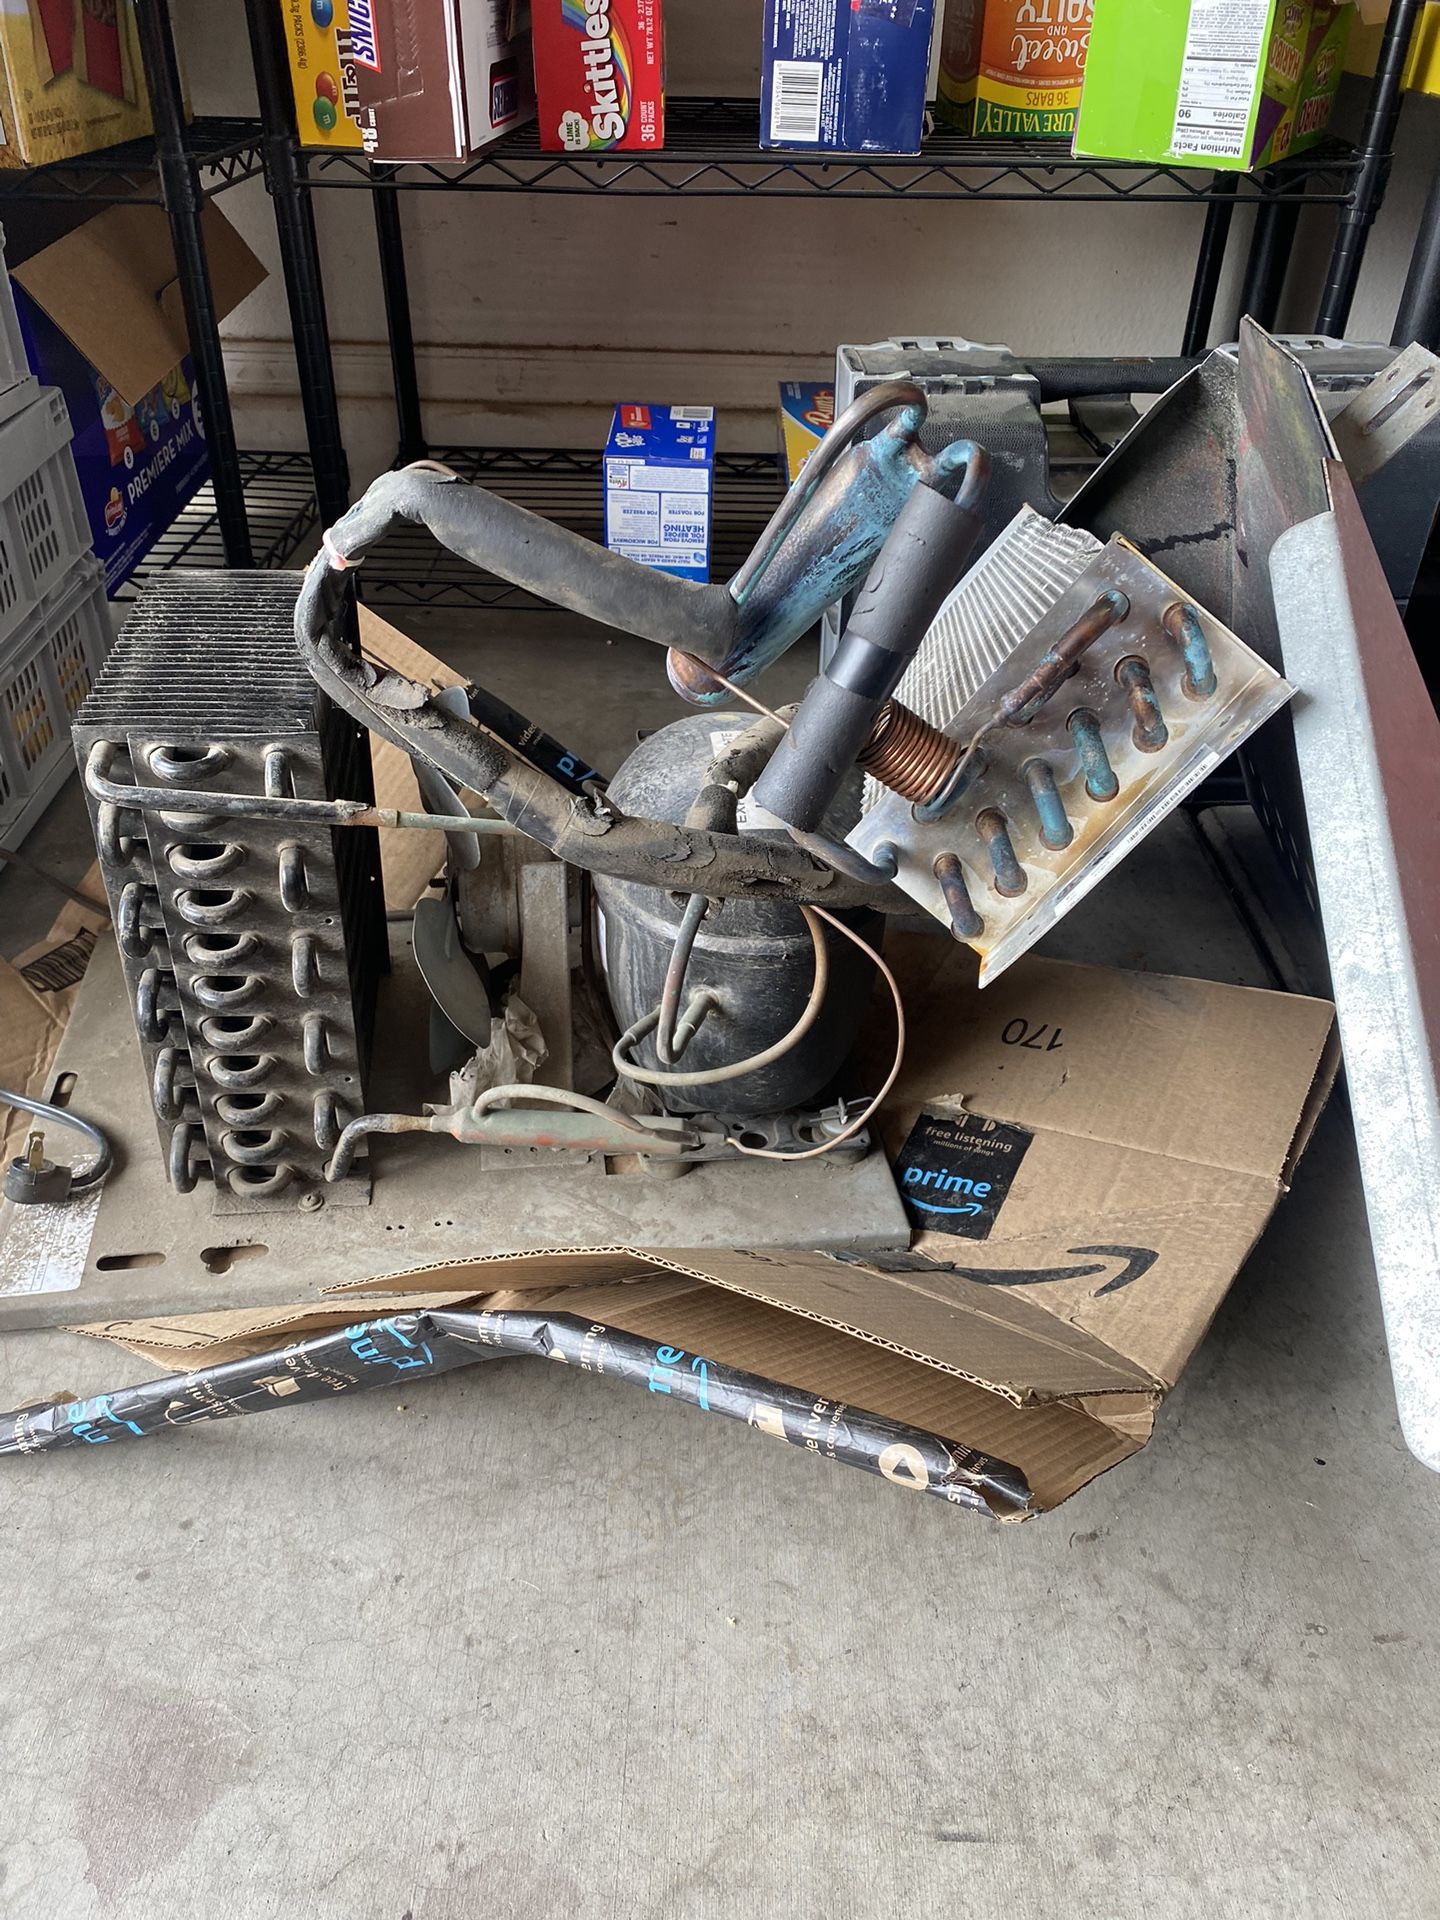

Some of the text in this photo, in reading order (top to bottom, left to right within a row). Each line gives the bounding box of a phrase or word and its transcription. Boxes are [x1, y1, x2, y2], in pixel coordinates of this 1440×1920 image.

[293, 15, 304, 36] PACKS
[638, 20, 646, 31] 36
[1047, 25, 1068, 36] AND
[647, 37, 655, 50] WT
[1011, 33, 1088, 71] Sweet
[647, 51, 655, 65] NET
[579, 0, 625, 140] Skittles
[1026, 91, 1069, 106] 36 BARS
[647, 101, 655, 123] PACKS
[979, 102, 1041, 133] VALLEY
[1178, 109, 1247, 120] Calories 90
[363, 128, 379, 153] 48
[575, 137, 581, 145] IS
[641, 123, 656, 142] 36
[1173, 141, 1241, 155] Nutrition Facts
[127, 445, 177, 505] PREMIERE
[174, 419, 194, 454] MIX
[663, 524, 705, 533] HEATING
[1001, 1017, 1064, 1052] 170
[925, 1126, 1014, 1154] free listening
[932, 1139, 965, 1153] millions
[964, 1145, 973, 1154] of
[903, 1165, 993, 1199] prime
